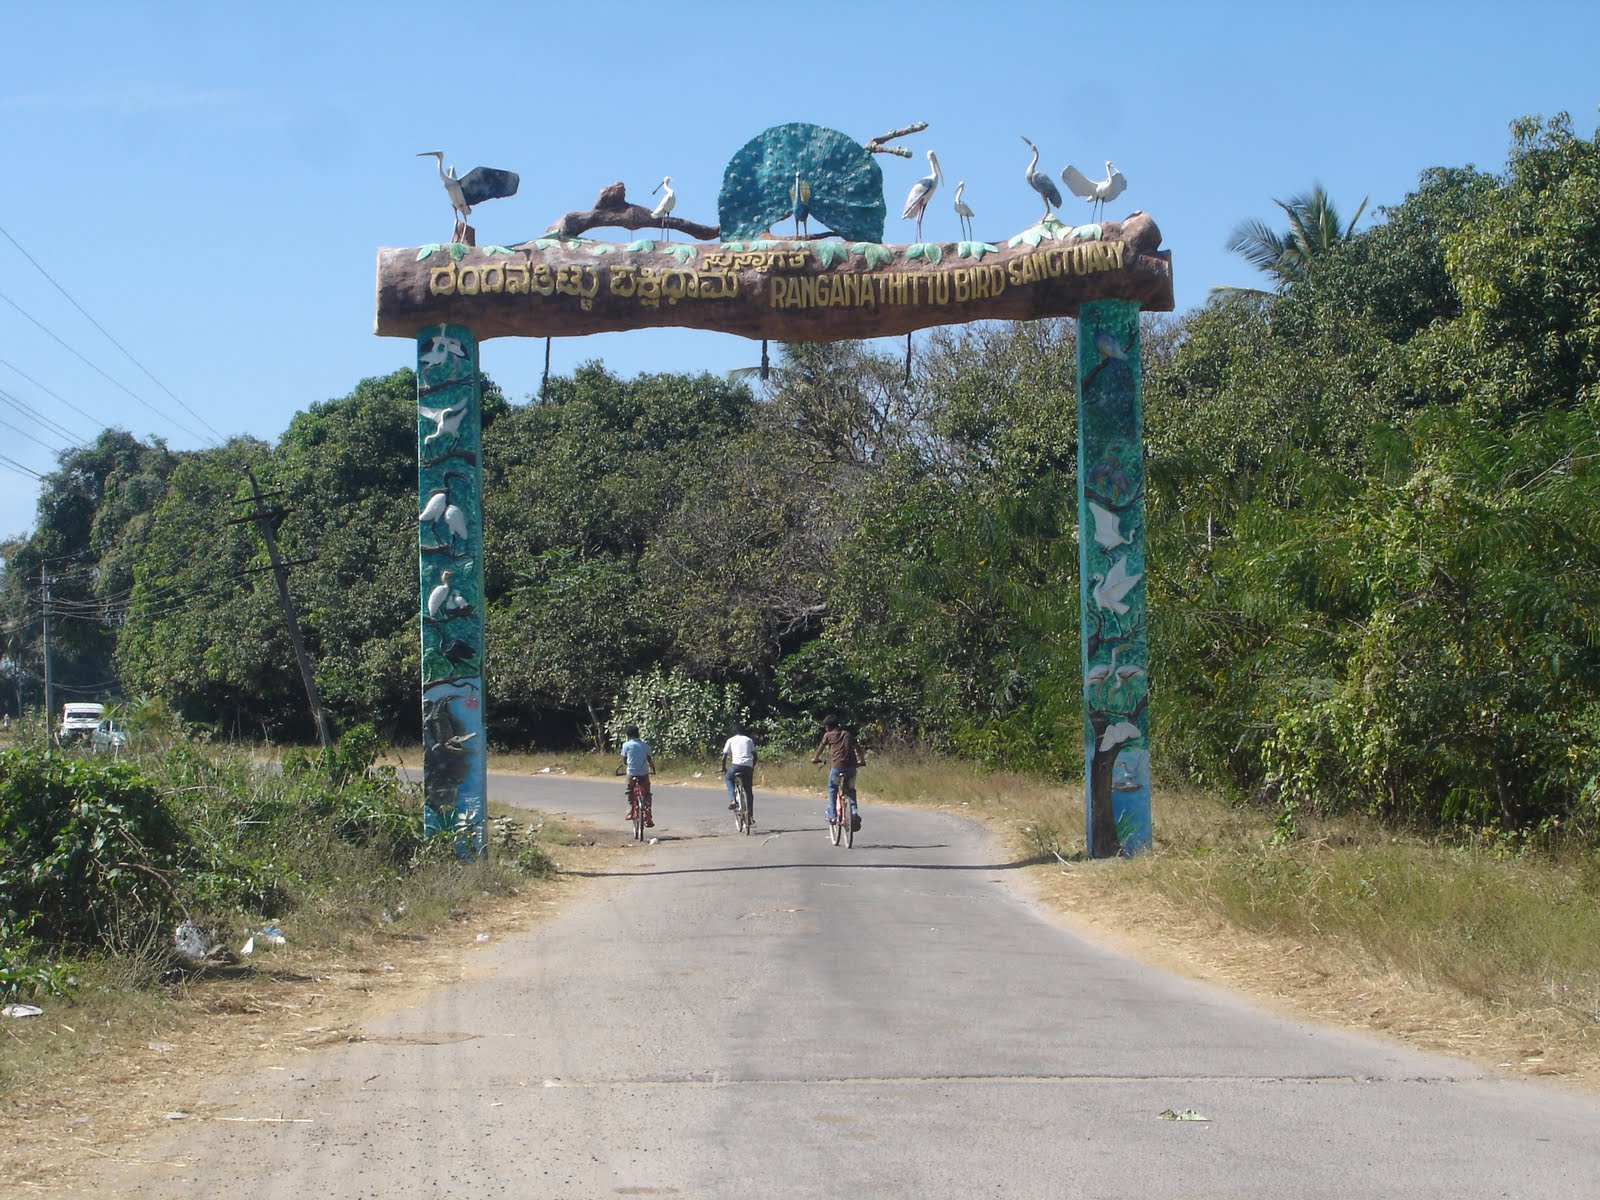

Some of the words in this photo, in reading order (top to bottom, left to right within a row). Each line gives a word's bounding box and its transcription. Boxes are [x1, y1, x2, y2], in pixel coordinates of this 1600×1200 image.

[769, 271, 949, 308] RANGANATHITTU
[954, 264, 1006, 303] BIRD
[1008, 240, 1125, 287] SANCTUARY
